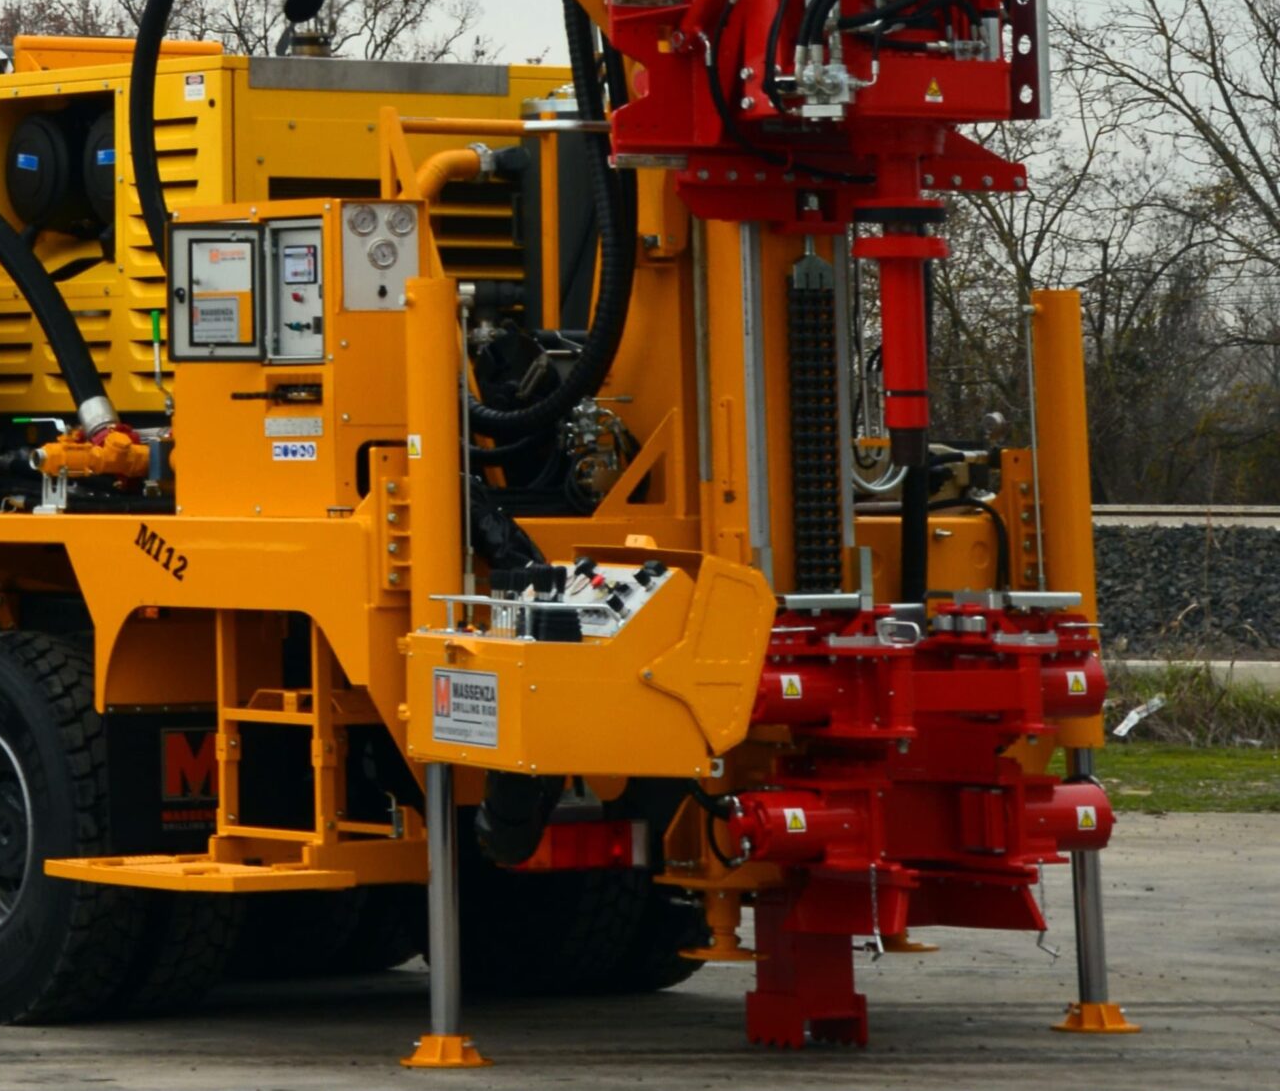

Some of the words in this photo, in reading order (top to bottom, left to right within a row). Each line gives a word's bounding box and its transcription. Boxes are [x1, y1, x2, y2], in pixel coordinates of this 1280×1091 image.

[134, 522, 188, 582] MI12
[452, 682, 496, 702] MASSENZA
[166, 732, 219, 797] M
